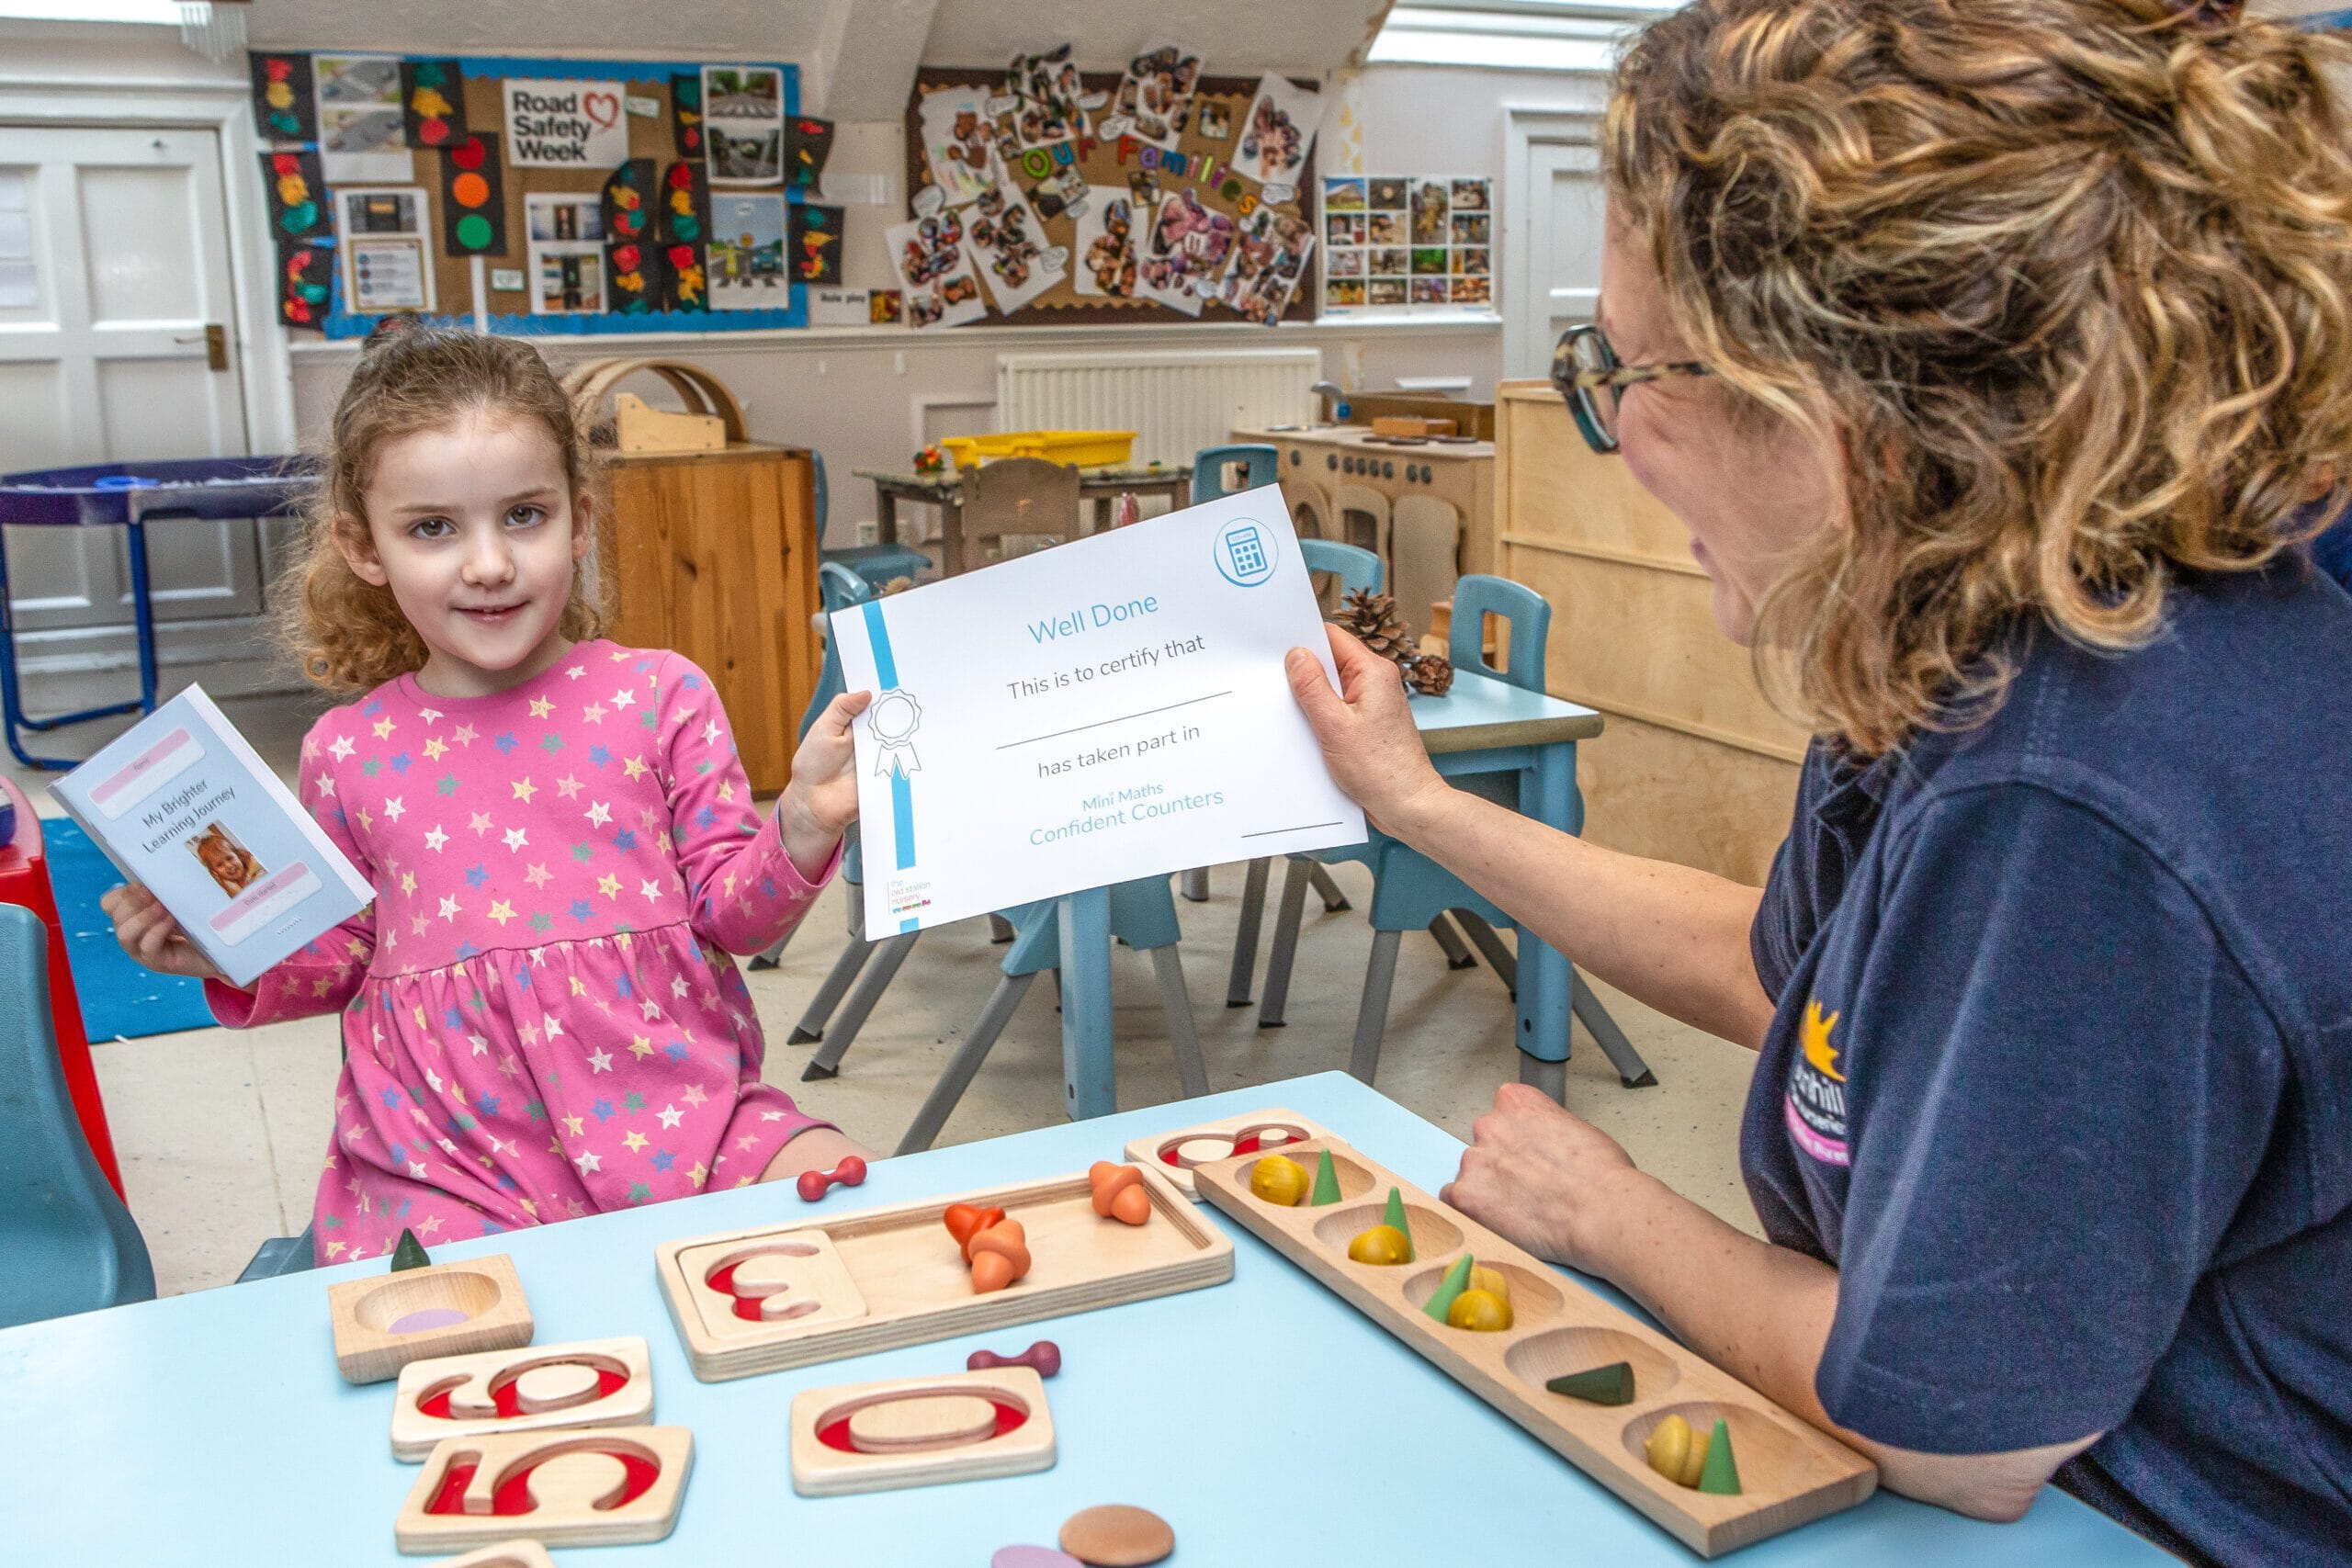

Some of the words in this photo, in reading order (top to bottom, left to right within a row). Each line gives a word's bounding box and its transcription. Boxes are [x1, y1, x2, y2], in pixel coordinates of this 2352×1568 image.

[513, 91, 577, 113] Road
[514, 116, 592, 141] Safety
[515, 140, 587, 161] Week
[1117, 134, 1259, 215] Families
[1028, 610, 1086, 644] Well
[1091, 596, 1159, 627] Done
[1007, 678, 1049, 699] This
[1054, 671, 1070, 688] is
[1074, 667, 1094, 682] to
[1100, 647, 1159, 676] certify
[1164, 635, 1206, 658] that
[1038, 760, 1072, 778] has
[1077, 745, 1130, 767] taken
[1137, 730, 1178, 756] part
[1182, 726, 1200, 740] in
[141, 810, 164, 829] My
[161, 779, 209, 816] Brighter
[141, 816, 197, 853] Learning
[194, 786, 236, 818] Journey
[1030, 810, 1126, 846] Confident
[1131, 791, 1225, 821] Counters
[1082, 795, 1114, 812] Mini
[1118, 784, 1164, 804] Maths
[905, 882, 931, 893] station
[423, 1437, 662, 1517] 5
